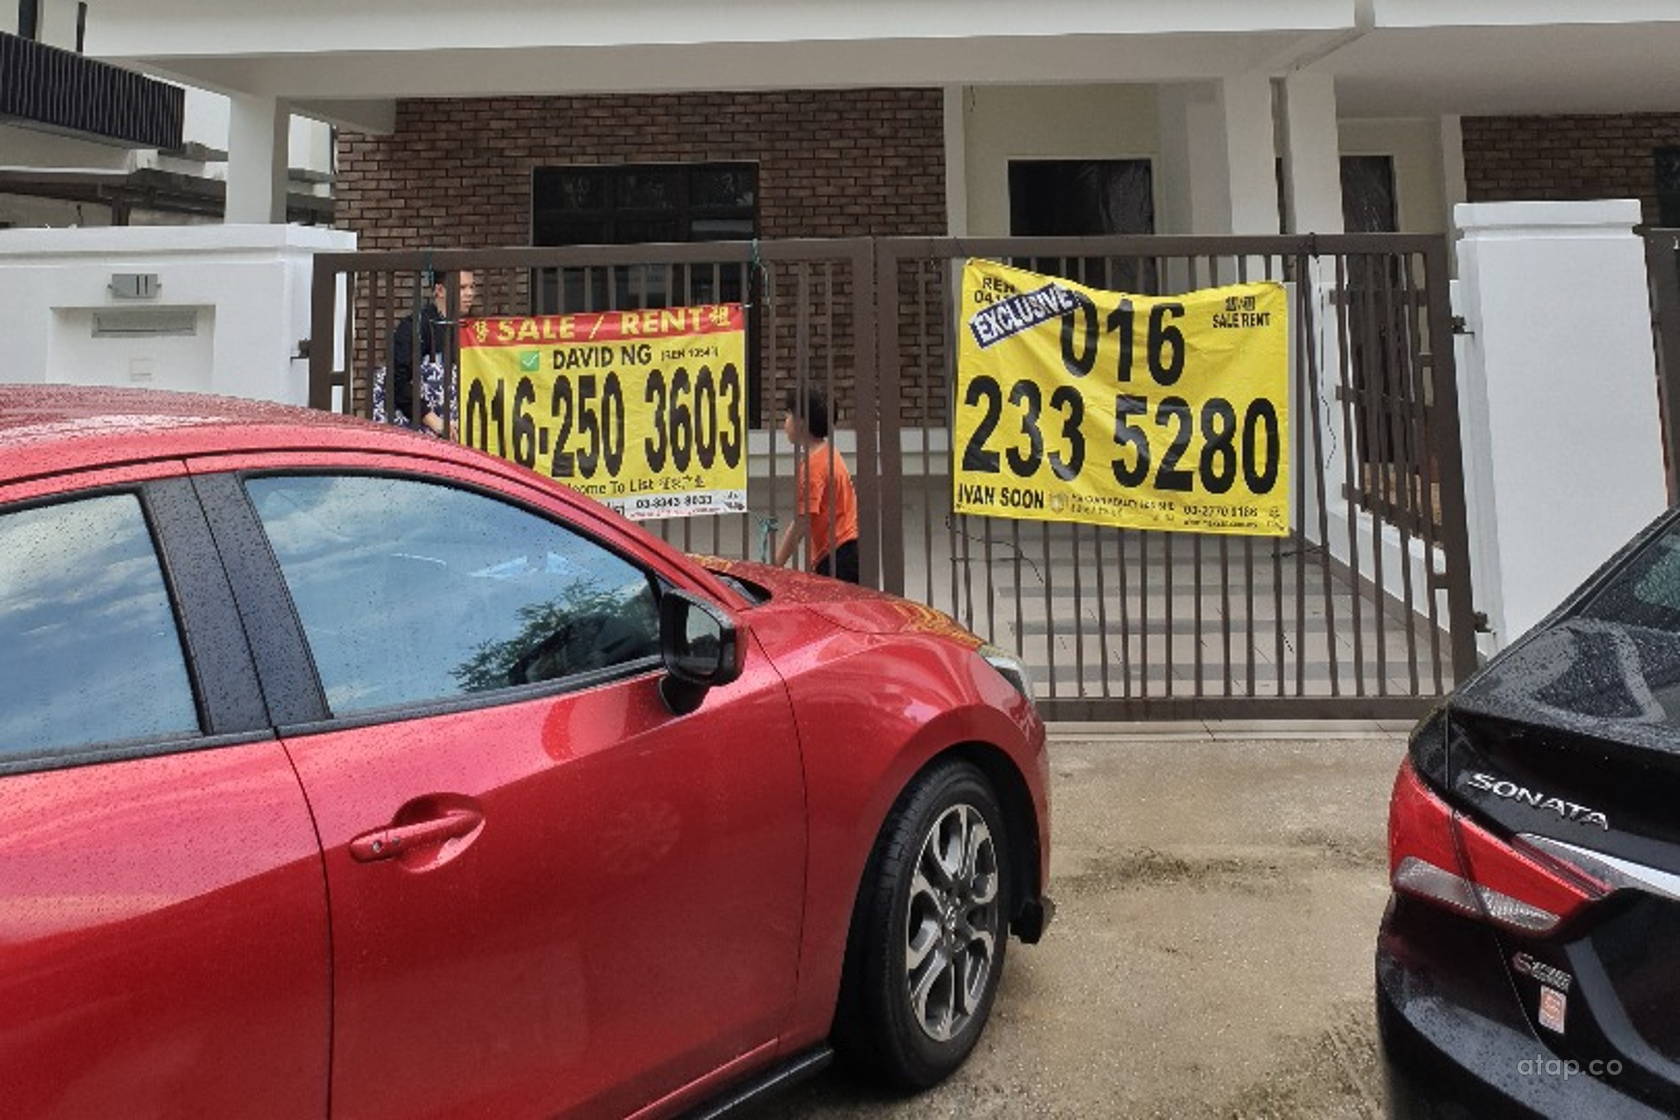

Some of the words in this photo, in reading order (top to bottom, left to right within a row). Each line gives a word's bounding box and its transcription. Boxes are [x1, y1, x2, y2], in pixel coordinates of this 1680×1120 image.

[497, 317, 576, 342] SALE
[621, 307, 704, 335] RENT
[975, 288, 1074, 343] EXCLUSIVE
[1060, 291, 1186, 386] 016
[553, 348, 613, 370] DAVID
[621, 344, 652, 366] NG
[645, 363, 741, 473] 3603
[962, 375, 1086, 481] 233
[1111, 394, 1281, 494] 5280
[629, 478, 654, 492] List
[958, 484, 995, 505] IVAN
[1000, 487, 1045, 509] SOON
[1468, 773, 1609, 830] SONATA
